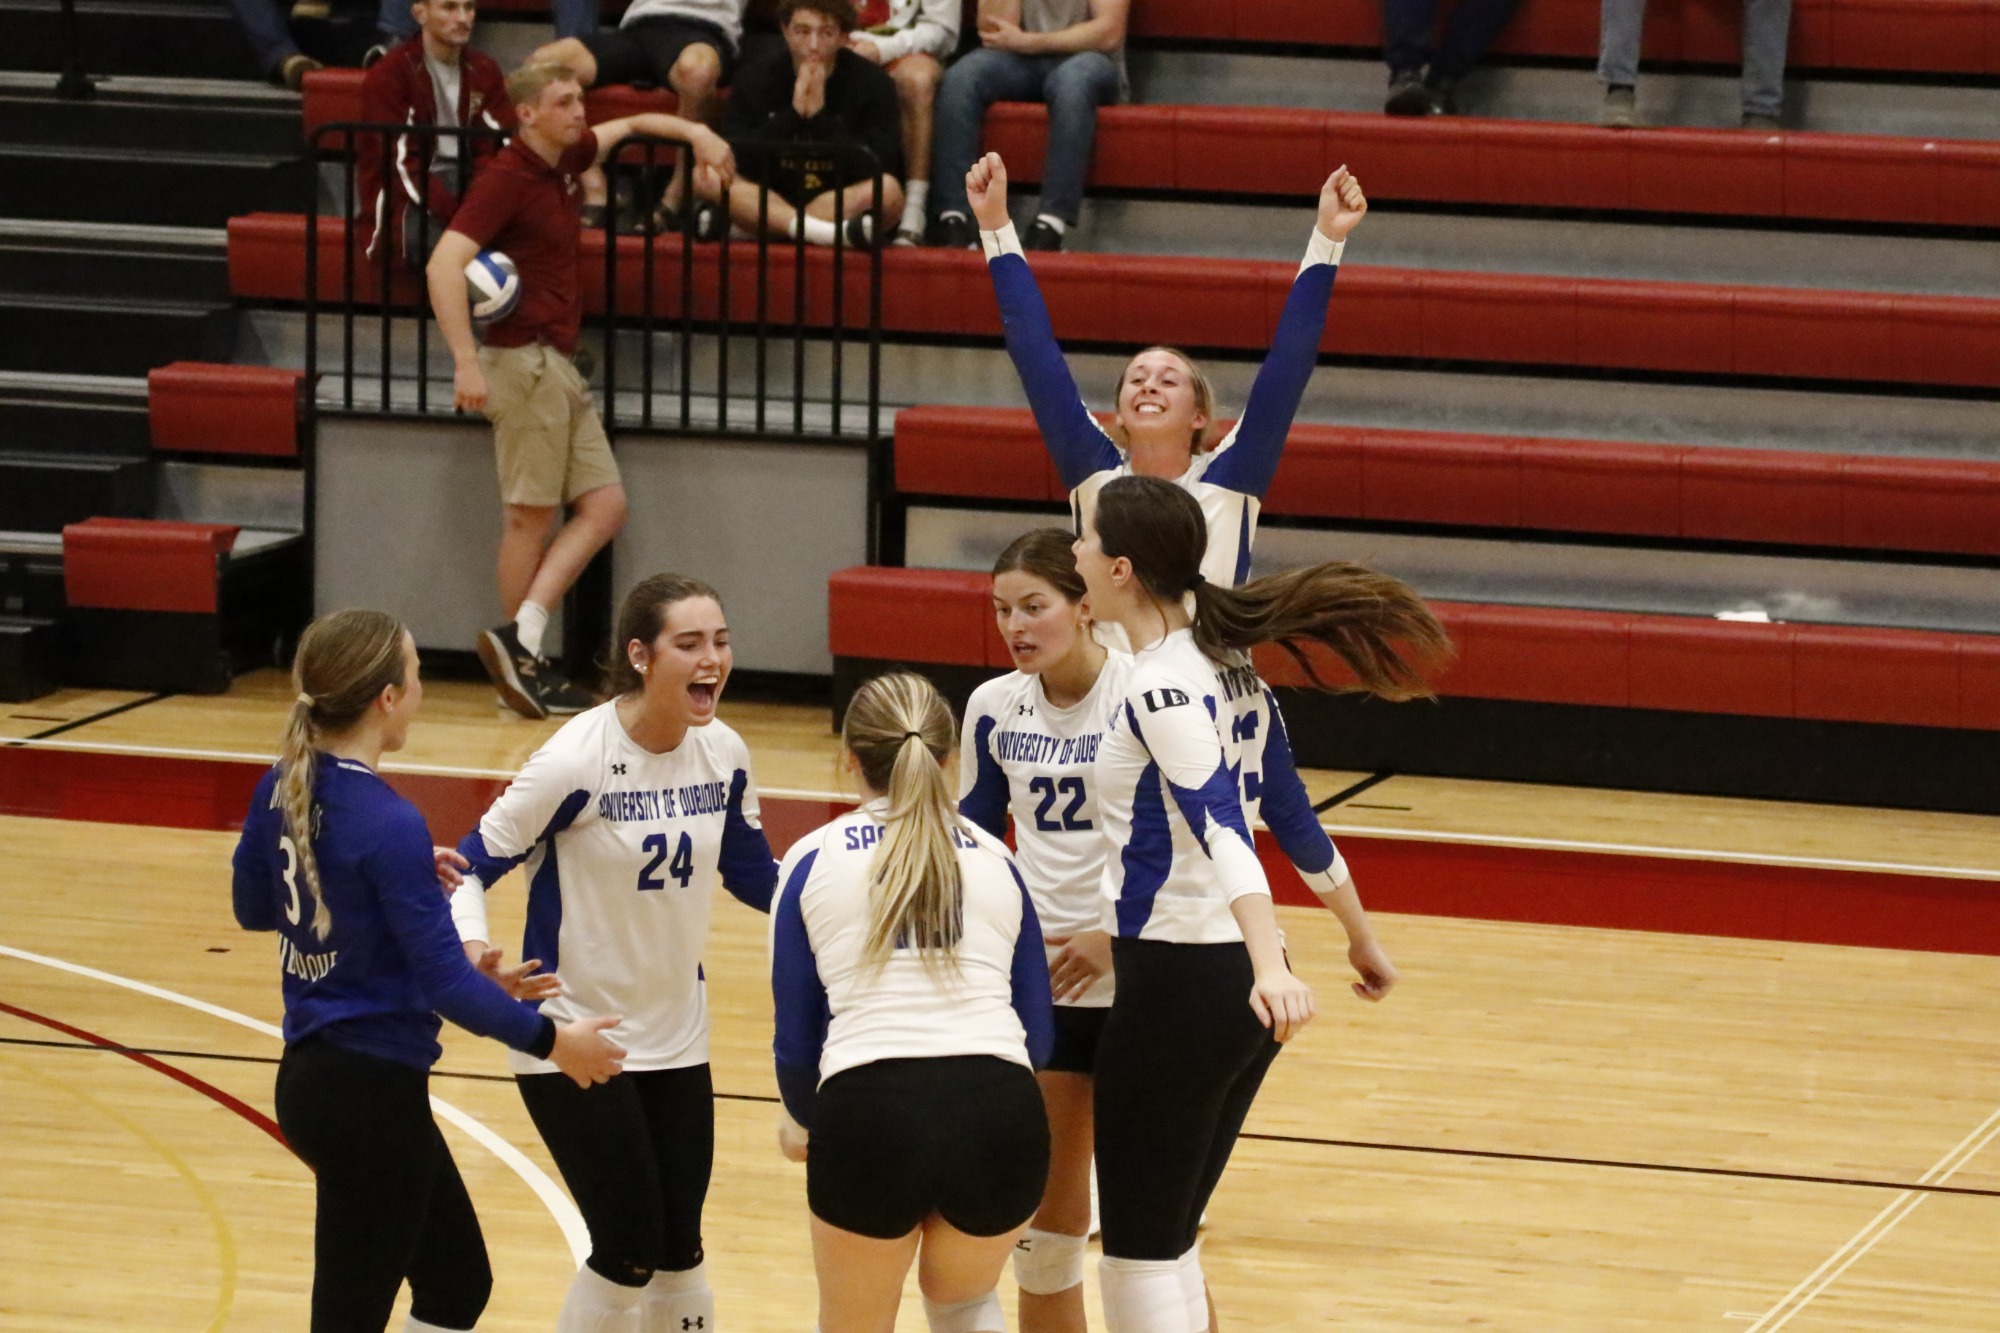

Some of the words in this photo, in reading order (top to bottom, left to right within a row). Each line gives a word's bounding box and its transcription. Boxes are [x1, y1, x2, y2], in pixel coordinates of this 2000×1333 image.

[998, 731, 1061, 764] UNIVERSITY
[1058, 738, 1076, 765] OF
[599, 790, 660, 822] UNIVERSITY
[662, 788, 676, 818] OF
[678, 781, 728, 817] DUBUQUE
[1029, 776, 1094, 831] 22
[279, 835, 301, 926] 3
[638, 831, 694, 891] 24
